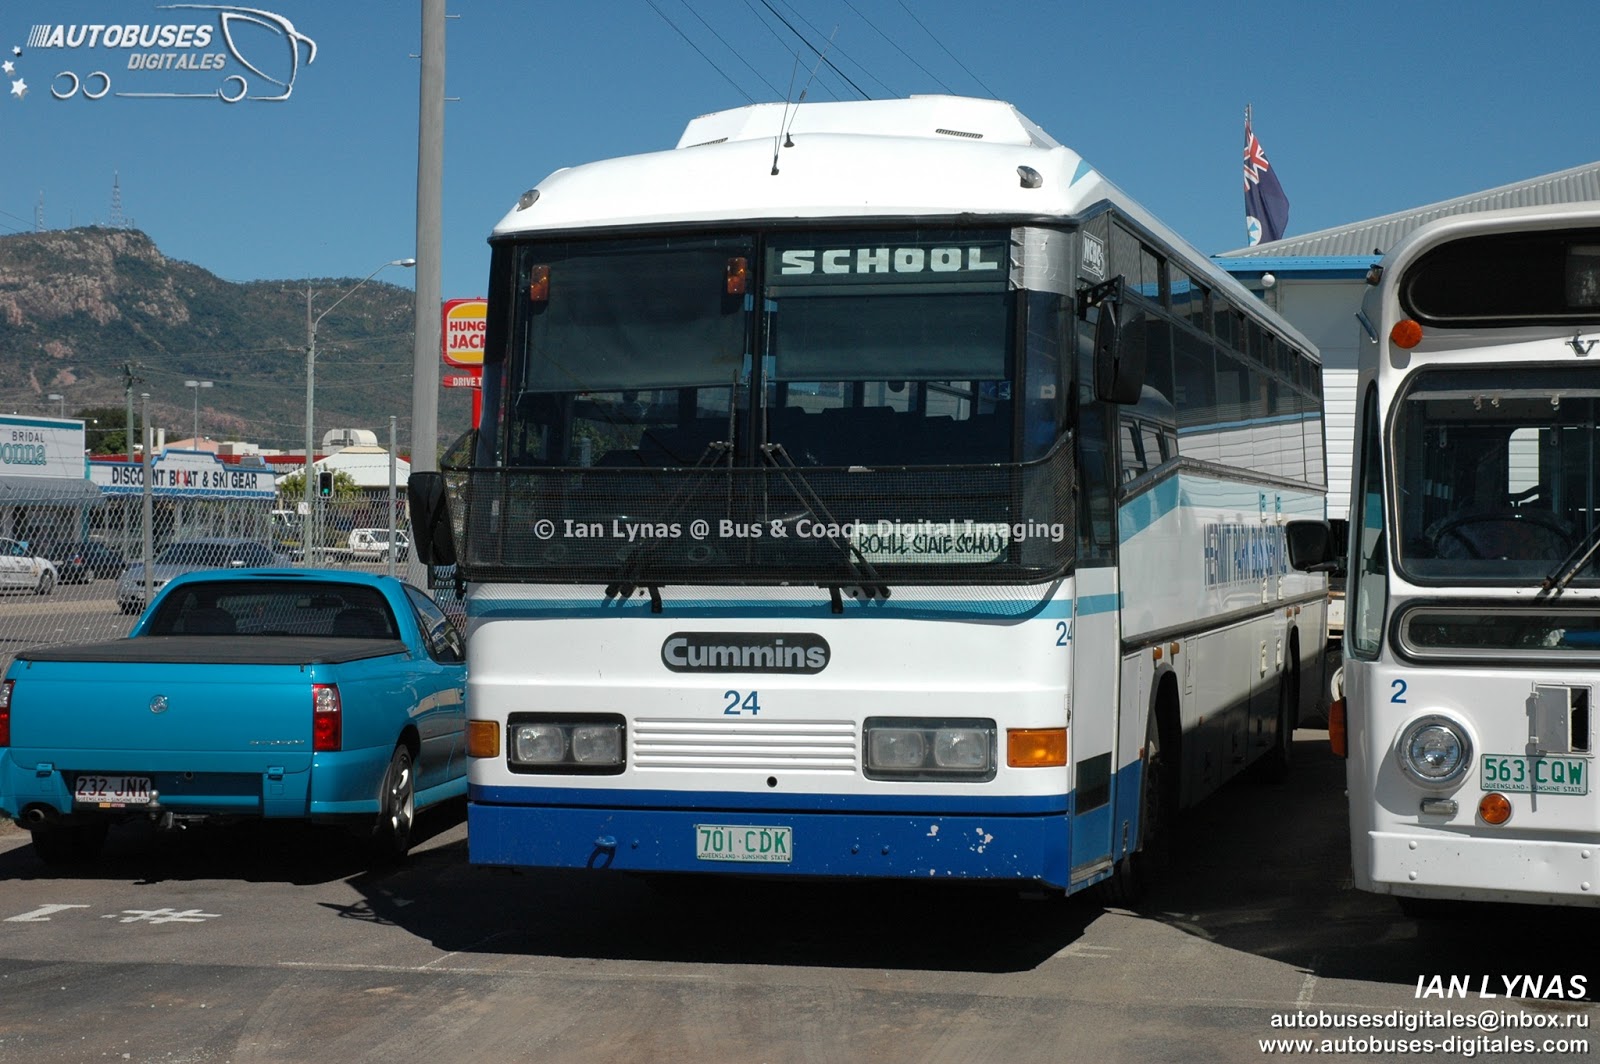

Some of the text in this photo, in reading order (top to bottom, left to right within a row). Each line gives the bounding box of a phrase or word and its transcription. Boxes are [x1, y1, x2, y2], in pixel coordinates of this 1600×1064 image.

[781, 247, 998, 275] SCHOOL
[453, 377, 476, 387] DRIVE
[12, 431, 45, 443] BRIDAL
[0, 442, 47, 465] onna
[112, 467, 165, 486] DISCONT
[202, 473, 210, 487] &
[212, 472, 228, 488] SKI
[231, 473, 258, 489] GEAR
[664, 638, 826, 668] Cummins
[724, 690, 760, 715] 24
[1390, 679, 1407, 704] 2
[1485, 758, 1524, 782] 563
[1531, 784, 1560, 792] SUNSHINE
[701, 829, 787, 854] 701 CDK
[700, 852, 736, 860] QUEENSLAND
